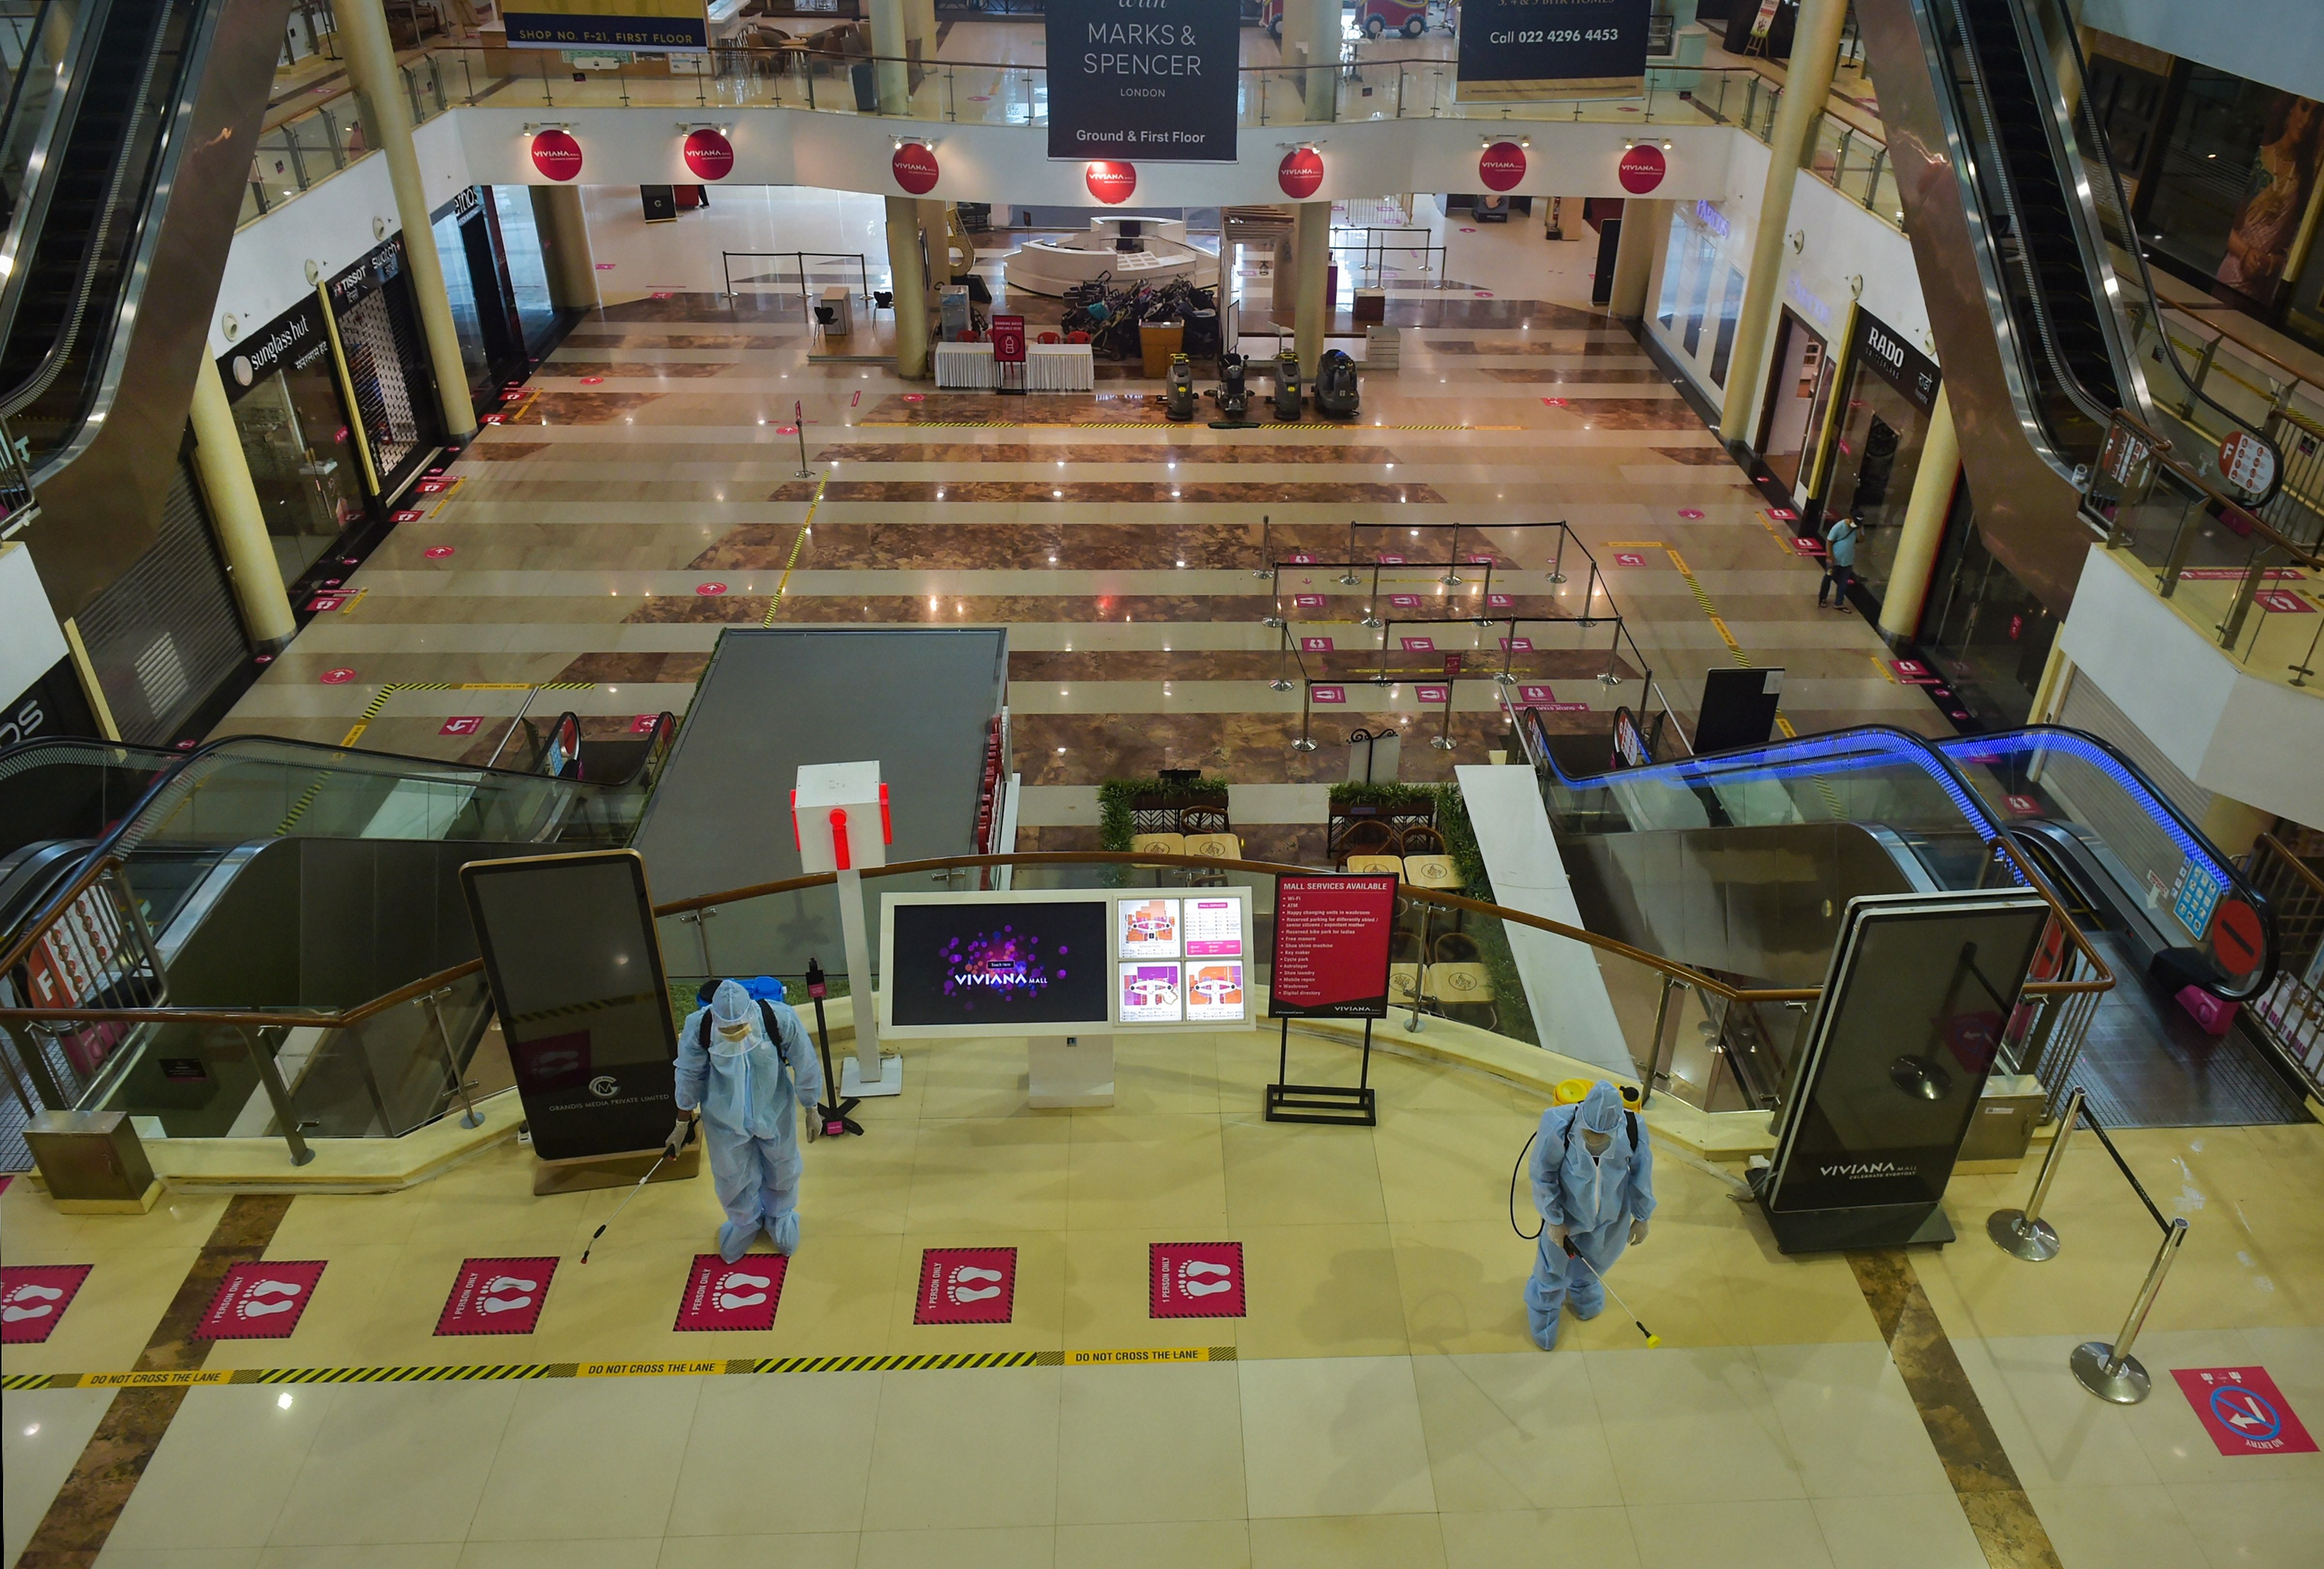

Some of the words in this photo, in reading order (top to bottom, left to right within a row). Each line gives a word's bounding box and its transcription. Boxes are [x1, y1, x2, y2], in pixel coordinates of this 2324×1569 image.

[519, 30, 551, 39] SHOP
[557, 30, 578, 40] NO.
[584, 32, 610, 42] F-21,
[616, 33, 647, 43] FIRST
[654, 33, 692, 44] FLOOR
[1089, 23, 1174, 45] MARKS
[1180, 25, 1196, 46] &
[1490, 31, 1514, 44] Call
[1518, 31, 1544, 43] 022
[1547, 30, 1581, 42] 4296
[1585, 29, 1618, 41] 4453
[1084, 53, 1201, 76] SPENCER
[1120, 88, 1165, 97] LONDON
[1076, 129, 1123, 141] Ground
[1127, 131, 1136, 141] &
[1140, 131, 1169, 142] First
[1173, 132, 1206, 143] Floor
[895, 163, 927, 171] VIVIANA
[371, 243, 397, 269] swatch
[341, 266, 367, 291] TISSOT
[251, 329, 292, 370] sunglass
[288, 315, 309, 340] hut
[1868, 326, 1904, 367] RADO
[2223, 442, 2234, 459] F
[37, 968, 53, 1001] F
[954, 973, 1027, 985] VIVIANA
[549, 1104, 583, 1112] GRANDIS
[641, 1094, 669, 1102] LIMITED
[1820, 1162, 1895, 1176] VIVIANA
[932, 1262, 942, 1278] ONLY
[455, 1290, 472, 1314] PERSON
[465, 1272, 478, 1288] ONLY
[692, 1285, 706, 1310] PERSON
[700, 1268, 711, 1284] ONLY
[929, 1279, 940, 1304] PERSON
[214, 1293, 235, 1319] PERSON
[231, 1276, 244, 1293] ONLY
[1076, 1353, 1089, 1361] DO
[1093, 1353, 1113, 1361] NOT
[1116, 1352, 1149, 1360] CROSS
[1152, 1351, 1170, 1359] THE
[1173, 1350, 1198, 1359] LANE
[588, 1366, 603, 1374] DO
[605, 1365, 628, 1374] NOT
[629, 1364, 664, 1373] CROSS
[668, 1364, 687, 1372] THE
[689, 1363, 715, 1372] LANE
[90, 1375, 107, 1384] DO
[108, 1375, 132, 1384] NOT
[133, 1374, 169, 1383] CROSS
[171, 1373, 192, 1382] THE
[193, 1373, 221, 1382] LANE
[2246, 1439, 2274, 1449] ENTRY
[2271, 1437, 2284, 1447] NO
